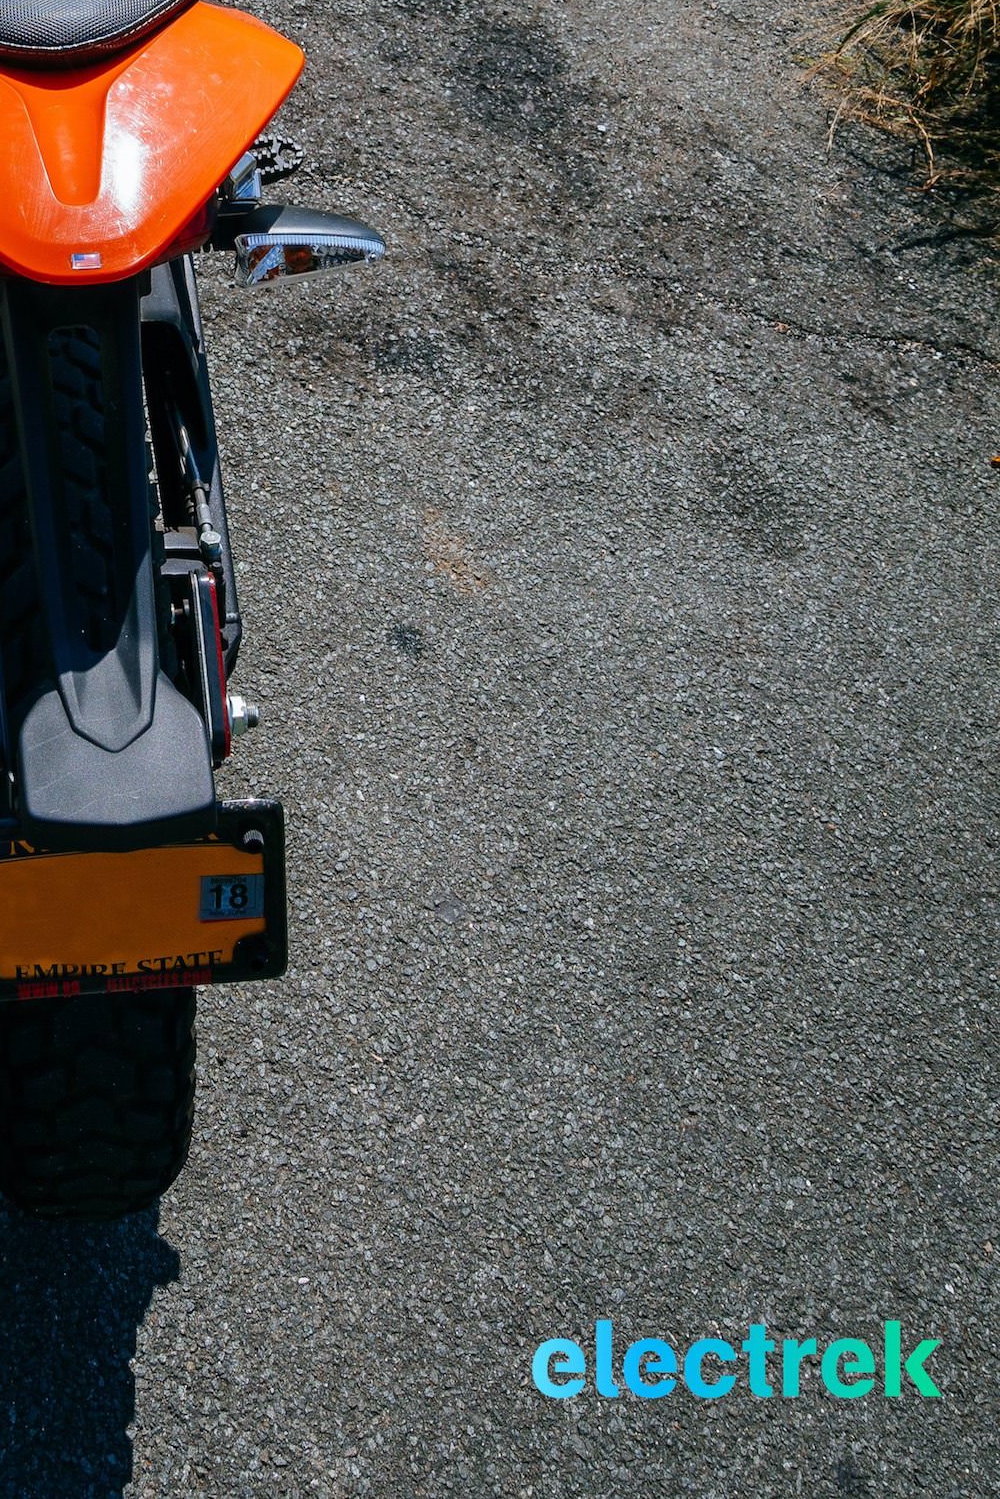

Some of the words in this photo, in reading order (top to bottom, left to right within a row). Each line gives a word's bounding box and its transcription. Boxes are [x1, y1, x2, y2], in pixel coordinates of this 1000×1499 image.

[209, 884, 248, 909] 18
[15, 962, 126, 979] EMPIRE
[137, 950, 223, 973] STATE
